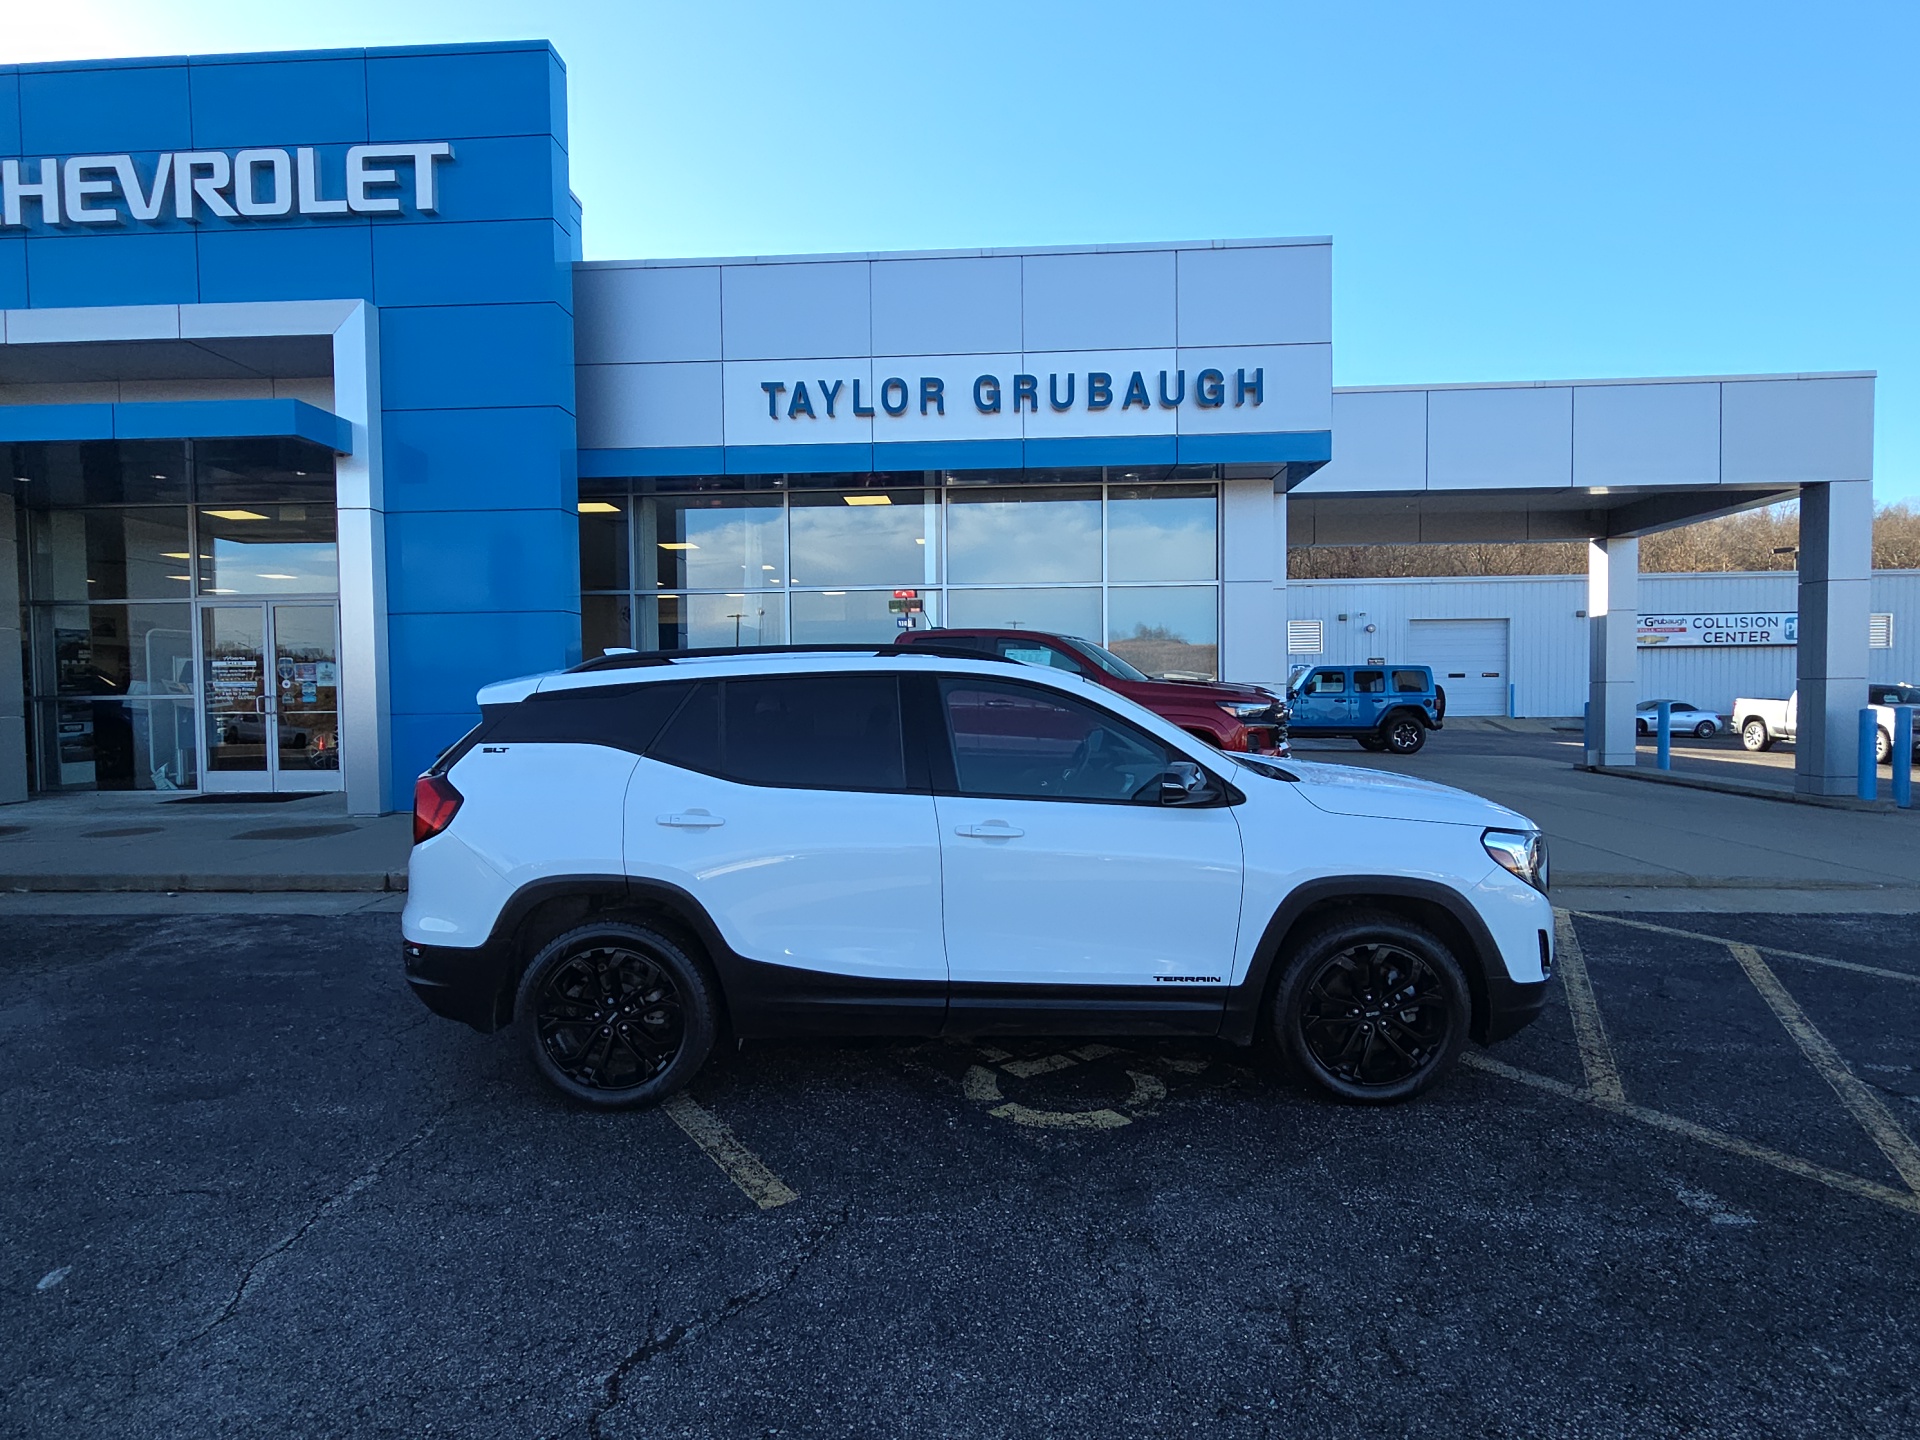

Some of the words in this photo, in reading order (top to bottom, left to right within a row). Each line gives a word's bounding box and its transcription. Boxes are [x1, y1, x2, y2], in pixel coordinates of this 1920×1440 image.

[0, 142, 453, 226] HEVROLET
[760, 376, 946, 420] TAYLOR
[972, 367, 1264, 413] GRUBAUGH
[1644, 617, 1687, 626] Grubaugh
[1692, 616, 1778, 629] COLLISION
[1702, 631, 1770, 643] CENTER
[1153, 975, 1221, 983] TERRAIN
